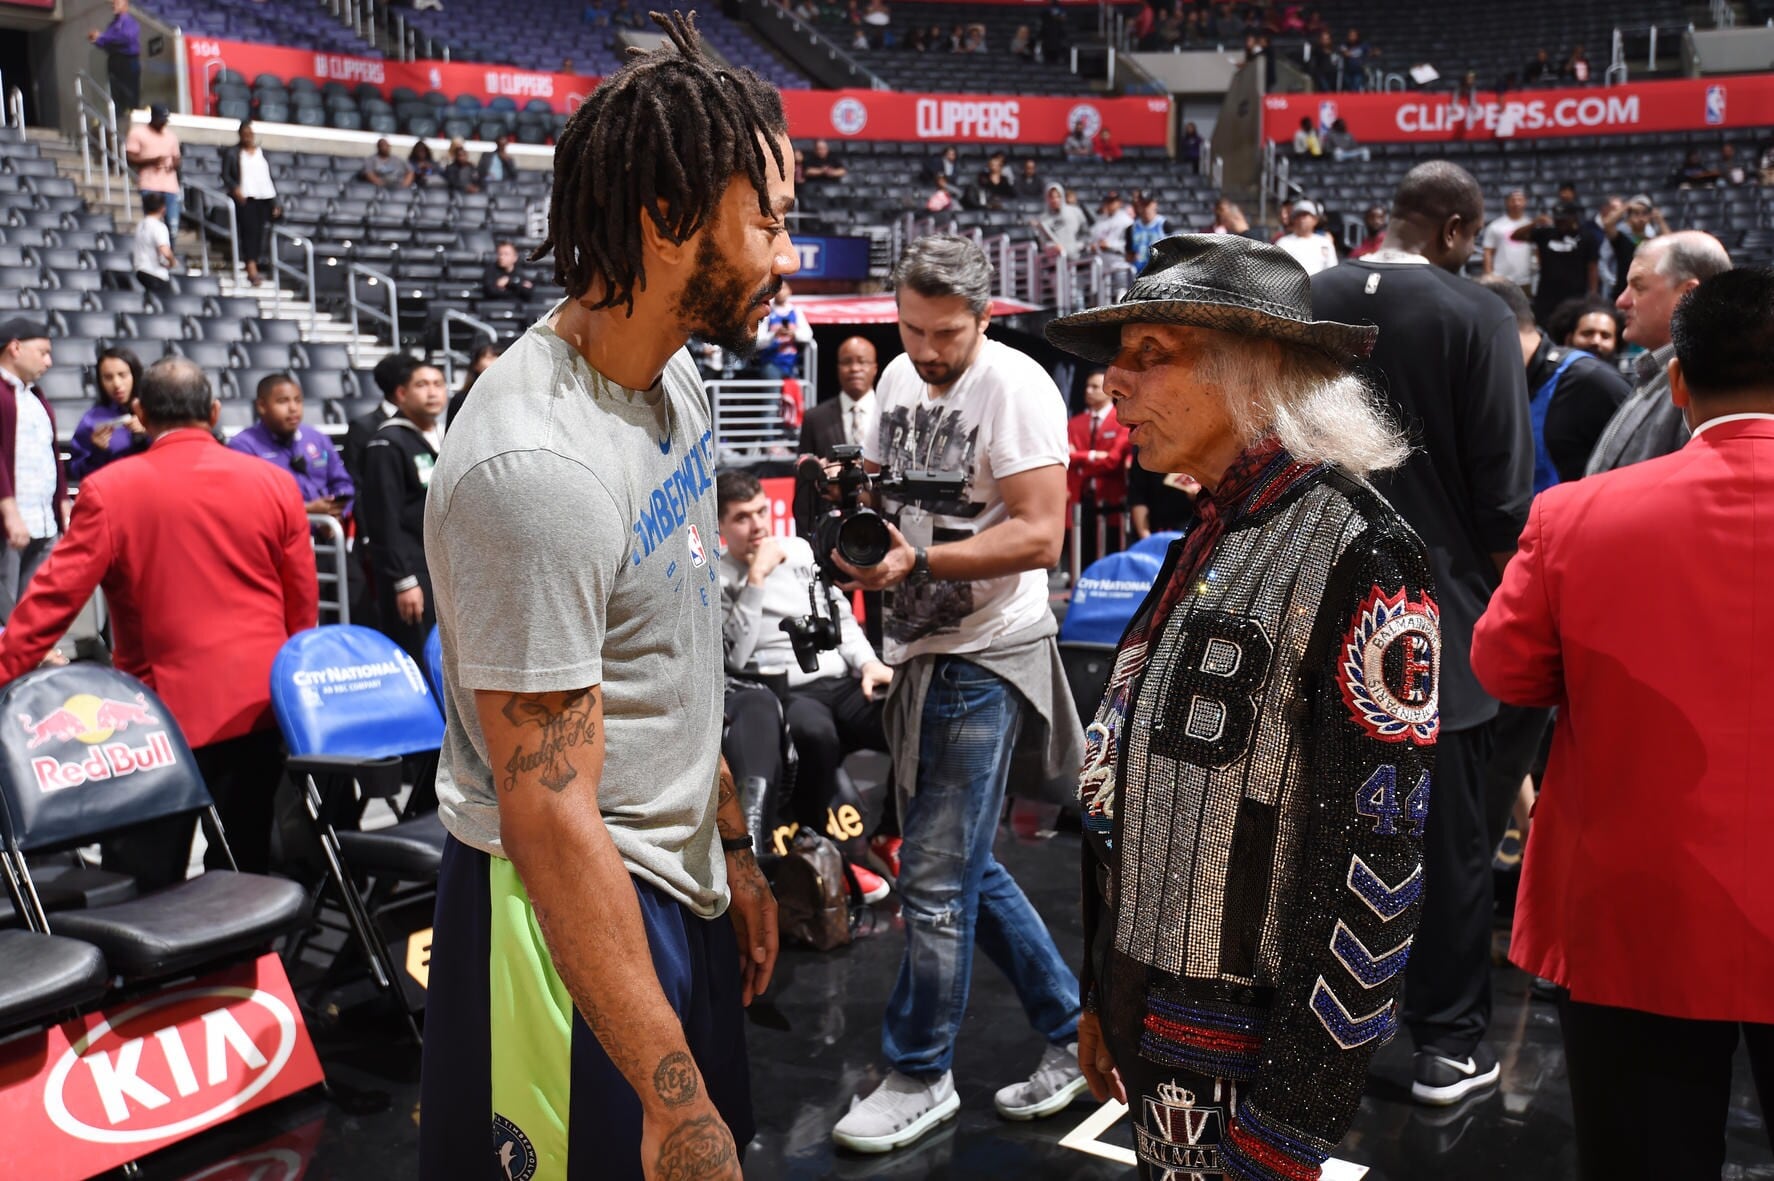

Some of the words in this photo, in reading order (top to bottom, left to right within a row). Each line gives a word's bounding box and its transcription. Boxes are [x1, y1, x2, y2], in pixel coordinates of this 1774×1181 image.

[330, 57, 385, 83] CLIPPERS
[501, 73, 554, 97] CLIPPERS
[916, 99, 1019, 139] CLIPPERS
[1396, 96, 1640, 132] CLIPPERS.COM
[325, 661, 401, 682] NATIONAL
[1150, 610, 1274, 771] B
[31, 744, 112, 792] Red
[102, 731, 176, 777] Bull
[83, 1008, 268, 1125] KIA
[1139, 1134, 1220, 1169] BALMAI
